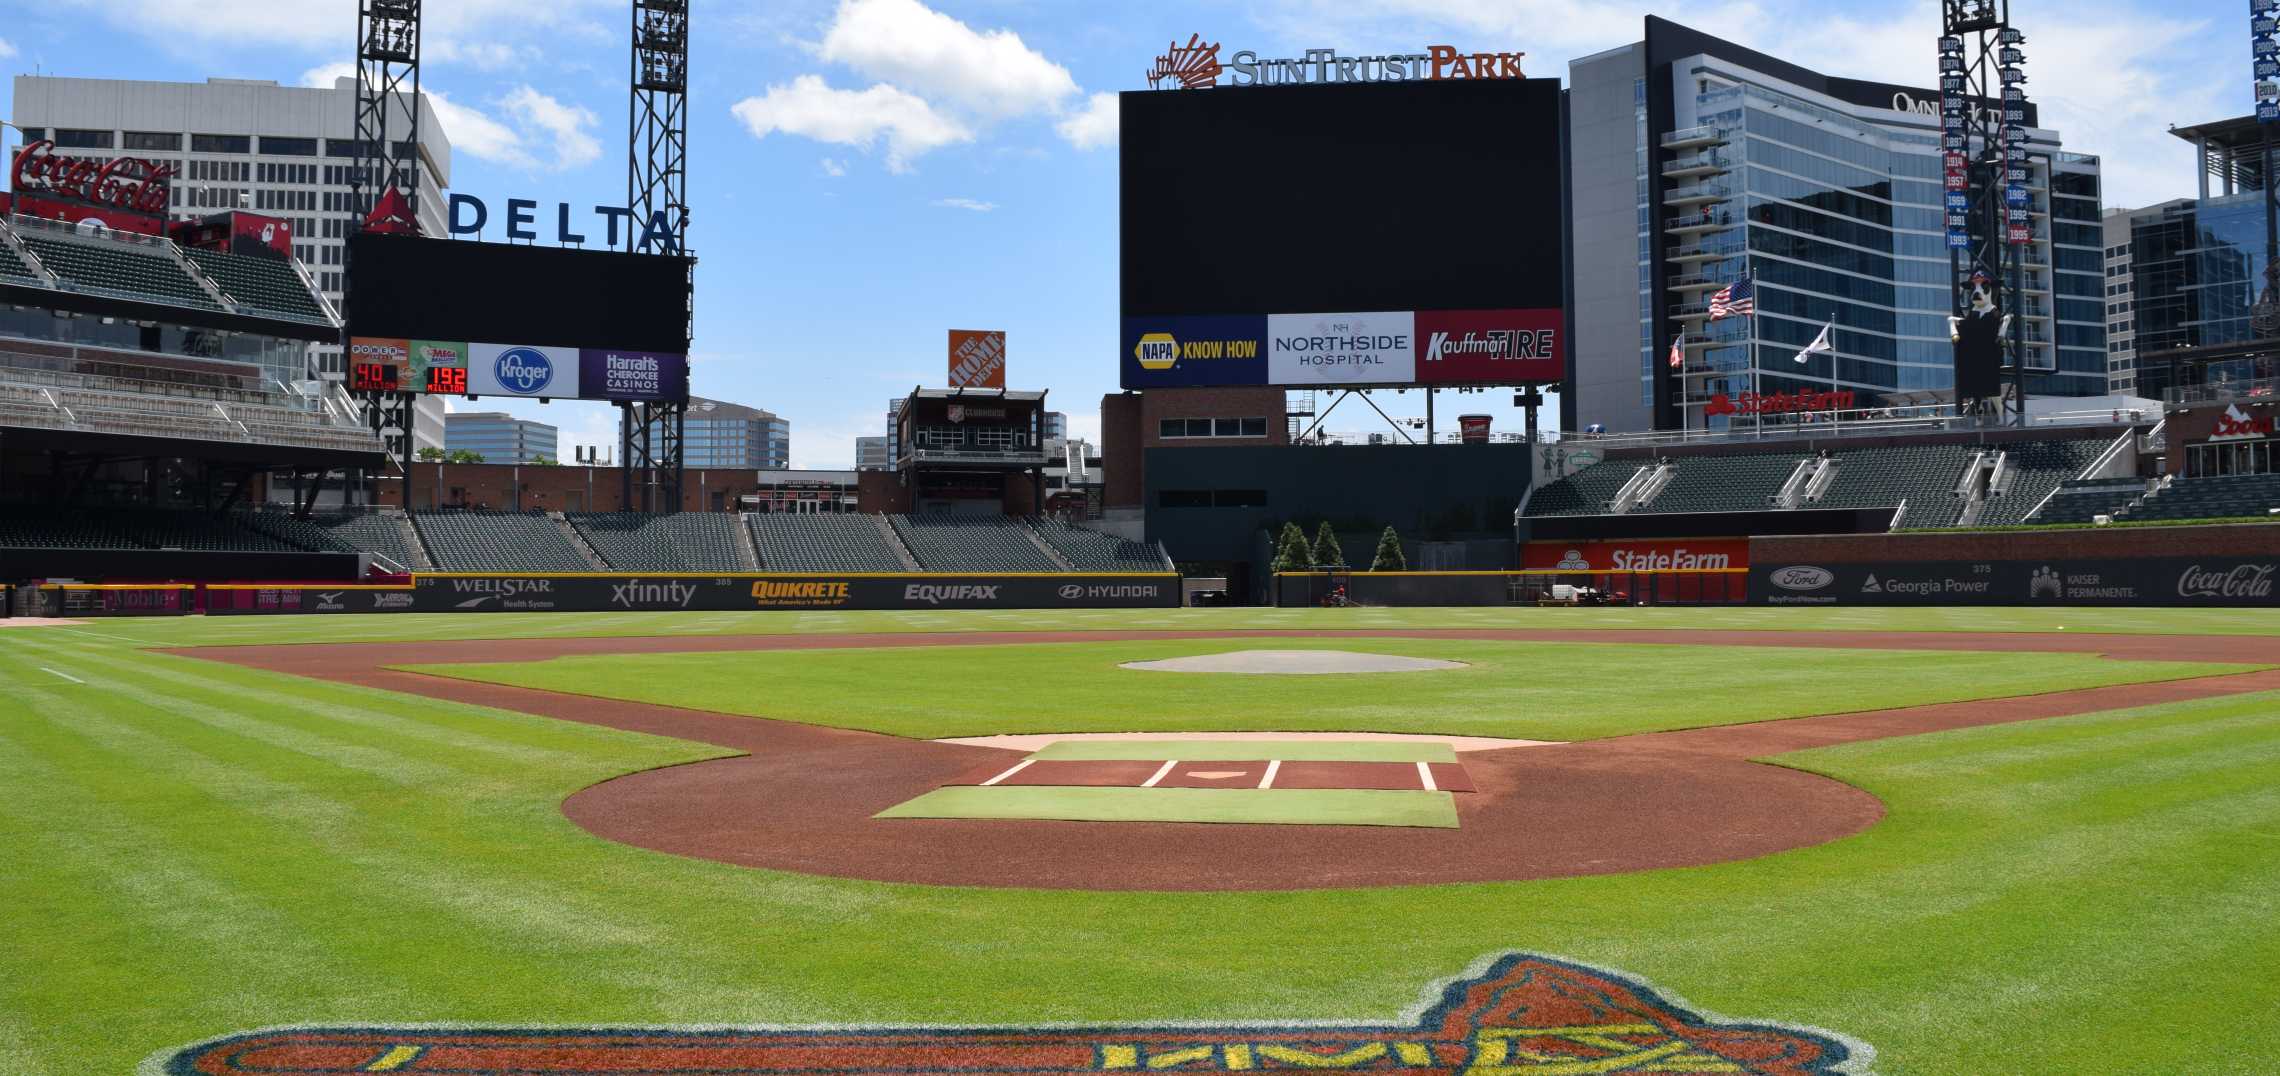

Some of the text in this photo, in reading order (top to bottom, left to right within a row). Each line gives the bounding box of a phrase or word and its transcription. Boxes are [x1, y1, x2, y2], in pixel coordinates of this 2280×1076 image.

[2256, 21, 2275, 31] 2000
[2003, 31, 2019, 42] 1873
[1942, 39, 1959, 50] 1872
[2257, 42, 2276, 53] 2002
[2004, 51, 2020, 62] 1875
[1943, 59, 1960, 70] 1874
[2257, 63, 2278, 75] 2004
[1944, 79, 1960, 90] 1877
[2259, 84, 2278, 96] 2010
[2005, 91, 2022, 102] 1891
[2006, 110, 2024, 121] 1893
[2260, 106, 2279, 118] 2013
[2007, 130, 2024, 141] 1898
[1946, 137, 1962, 147] 1897
[2008, 150, 2025, 161] 1948
[1947, 156, 1963, 167] 1914
[2008, 169, 2026, 181] 1958
[1948, 176, 1964, 187] 1957
[2009, 189, 2027, 201] 1982
[1949, 215, 1965, 226] 1991
[2009, 209, 2027, 221] 1992
[449, 193, 682, 256] DELTA
[1950, 235, 1967, 246] 1993
[2010, 229, 2028, 241] 1995
[1276, 335, 1408, 352] NORTHSIDE
[1488, 330, 1554, 360] TIRE
[352, 345, 398, 354] POWER
[1142, 340, 1257, 359] NAPA KNOW HOW
[949, 332, 1004, 386] HOME
[1300, 354, 1384, 365] HOSPITAL
[358, 364, 382, 381] 40
[501, 355, 549, 388] Kroger
[607, 370, 658, 380] CHEROKEE
[972, 352, 1004, 387] DEPOT
[433, 367, 465, 384] 192
[427, 384, 465, 392] MILLION
[607, 379, 658, 388] CASINOS
[1783, 570, 1819, 585] Ford
[2067, 575, 2101, 585] KAISER
[2178, 564, 2277, 597] Coca-Cola
[453, 580, 551, 596] WELLSTAR
[611, 578, 697, 607] xfinity
[751, 581, 849, 598] QUIKRETE
[1089, 586, 1157, 597] HYUNDAI
[1886, 579, 1989, 595] Georgia Power
[904, 584, 998, 603] EQUIFAX
[2067, 588, 2133, 598] PERMANENTE
[504, 600, 553, 609] Health System
